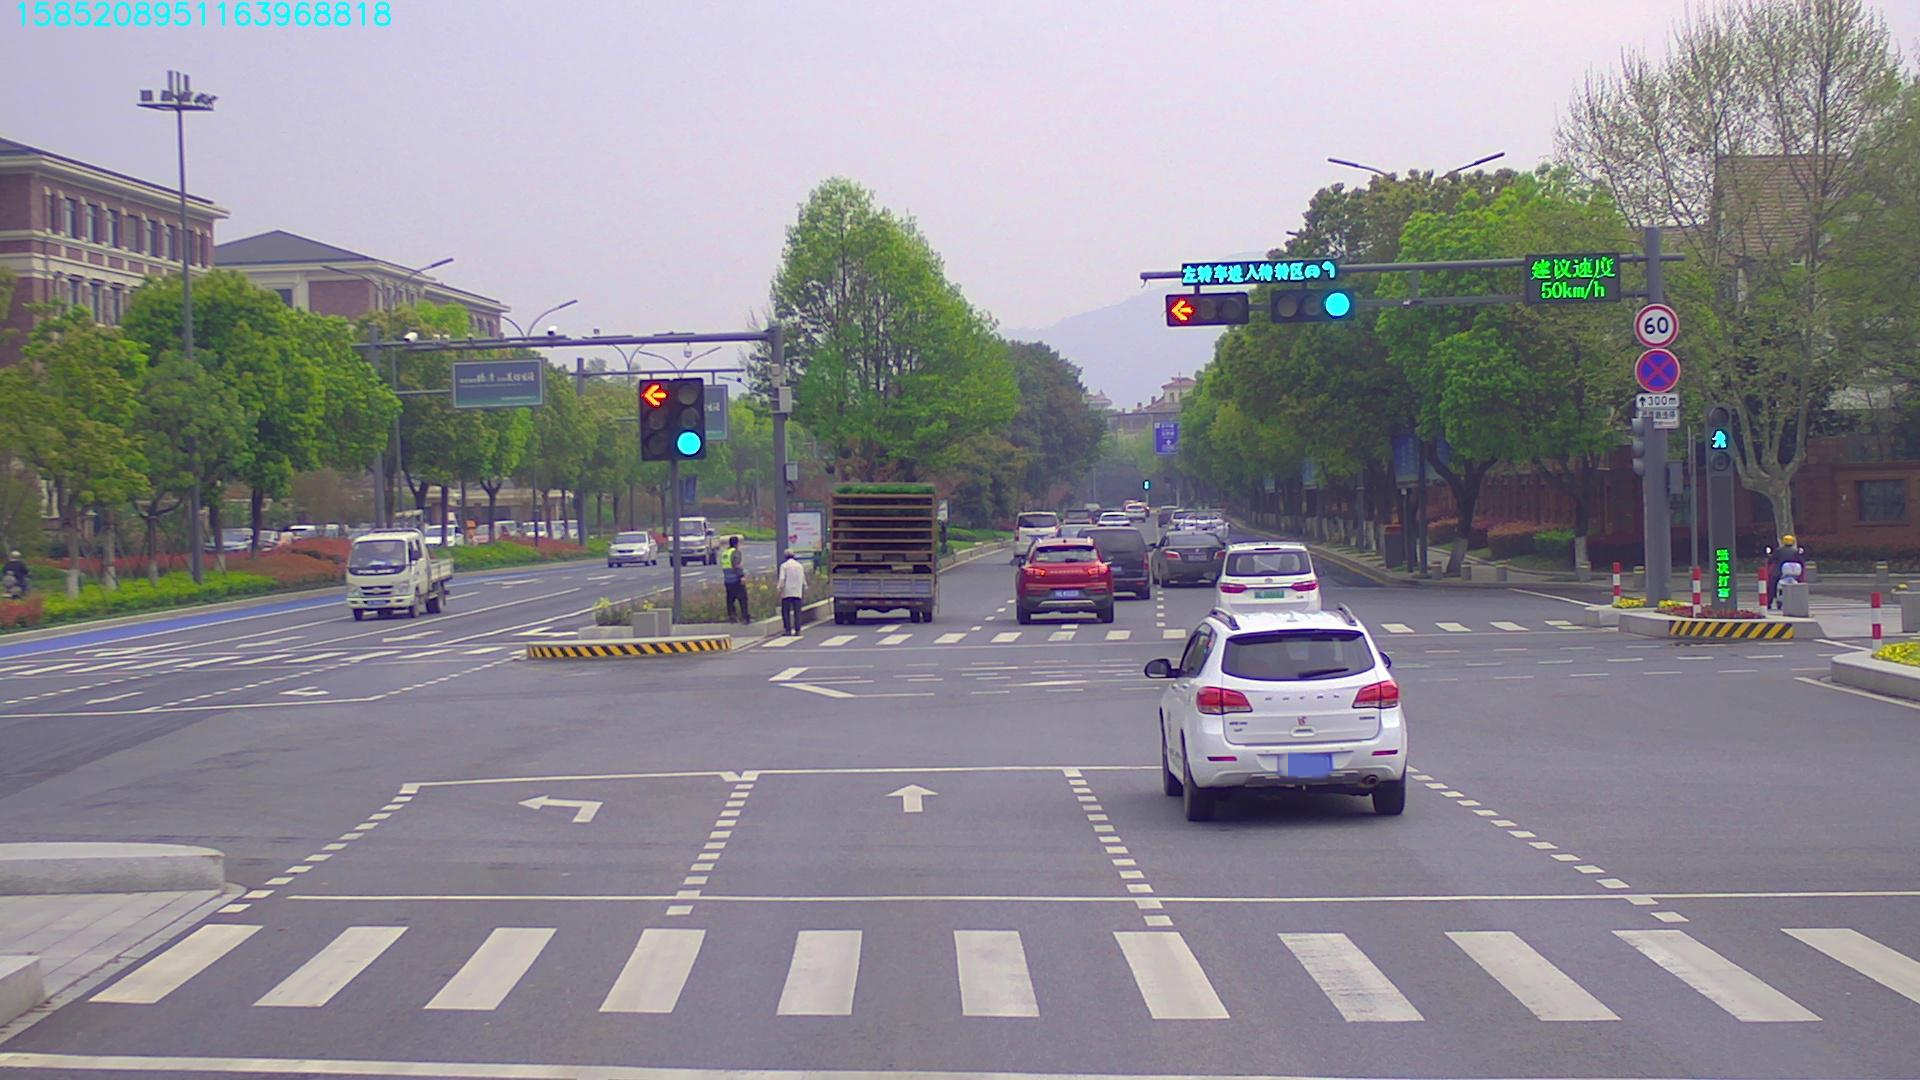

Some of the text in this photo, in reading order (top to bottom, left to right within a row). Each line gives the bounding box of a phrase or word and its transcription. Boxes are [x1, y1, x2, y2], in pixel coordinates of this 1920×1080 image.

[1531, 256, 1616, 280] 建议速度
[1540, 280, 1606, 300] 50km/h
[1644, 316, 1669, 335] 60
